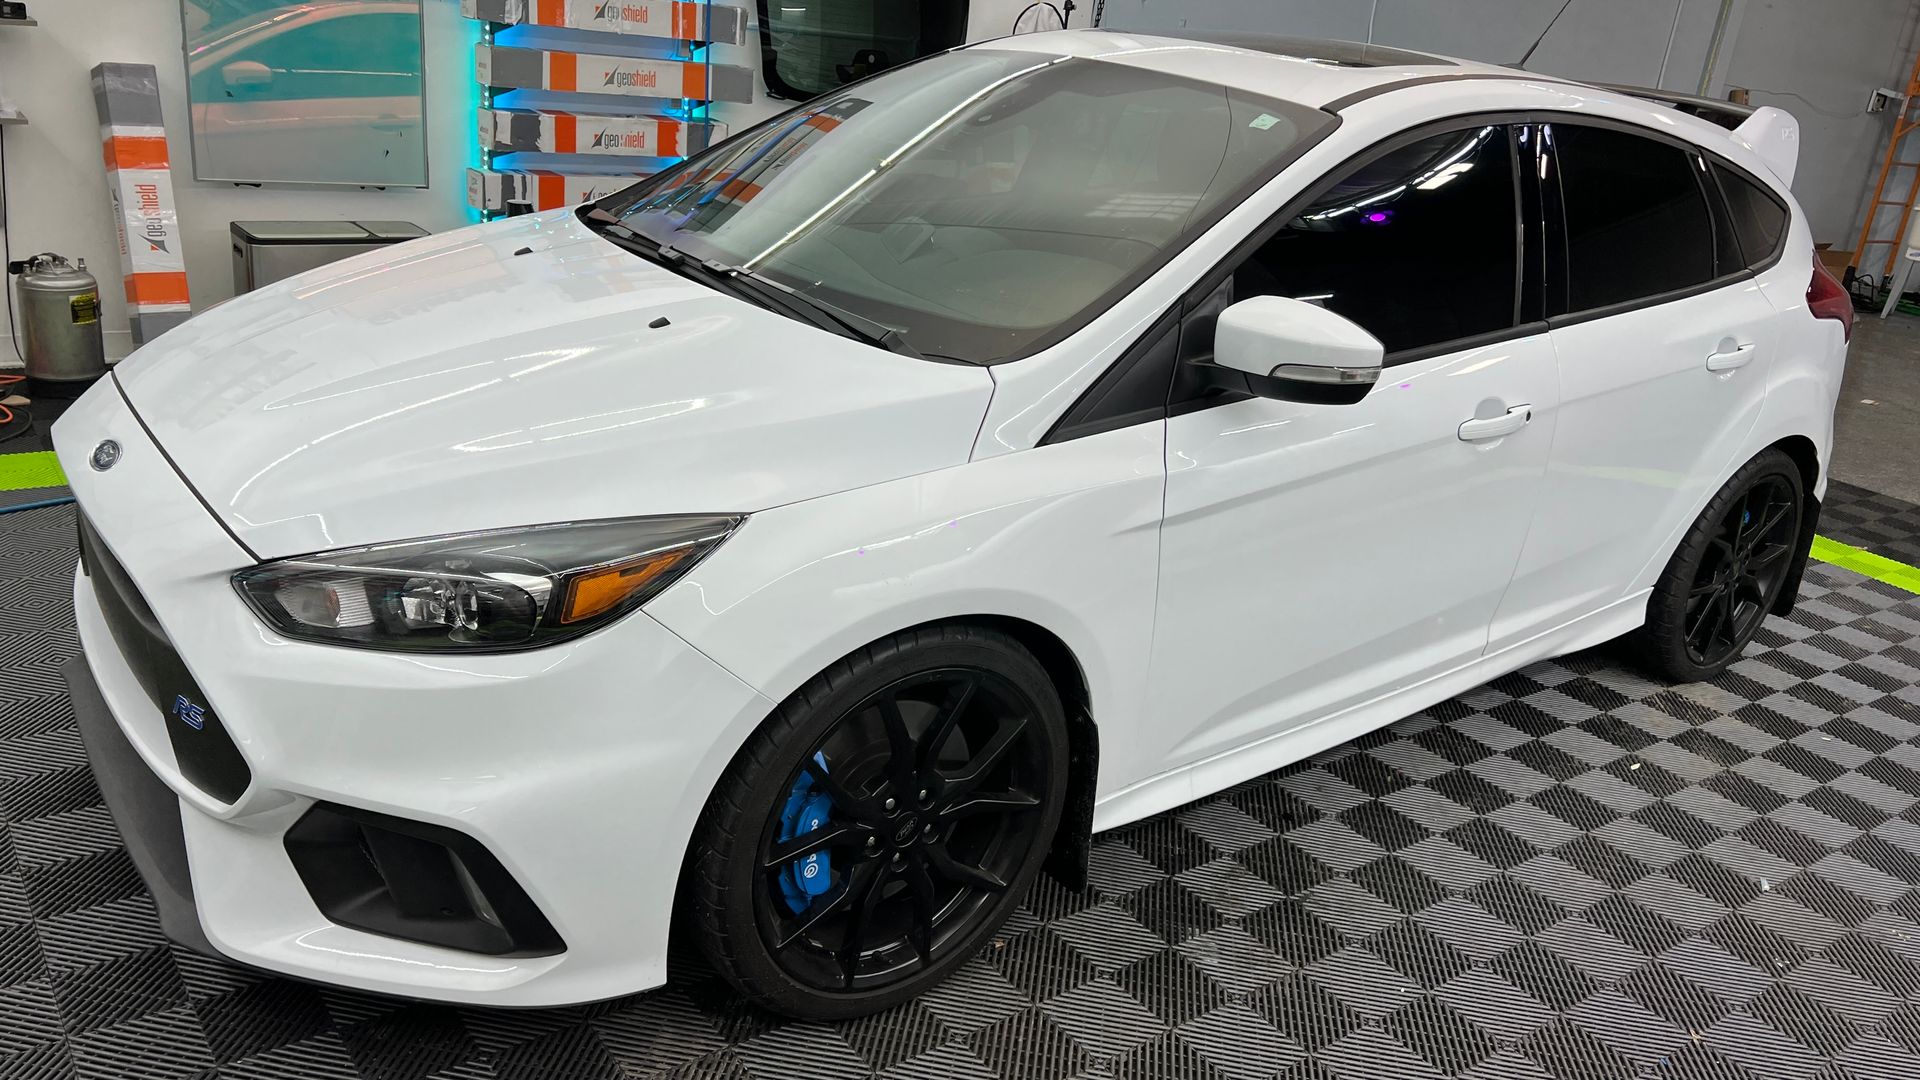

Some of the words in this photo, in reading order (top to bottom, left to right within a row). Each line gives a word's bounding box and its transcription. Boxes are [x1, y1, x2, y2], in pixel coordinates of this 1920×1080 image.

[616, 69, 657, 88] geoshield
[134, 184, 167, 237] geoshield
[172, 694, 206, 730] RS
